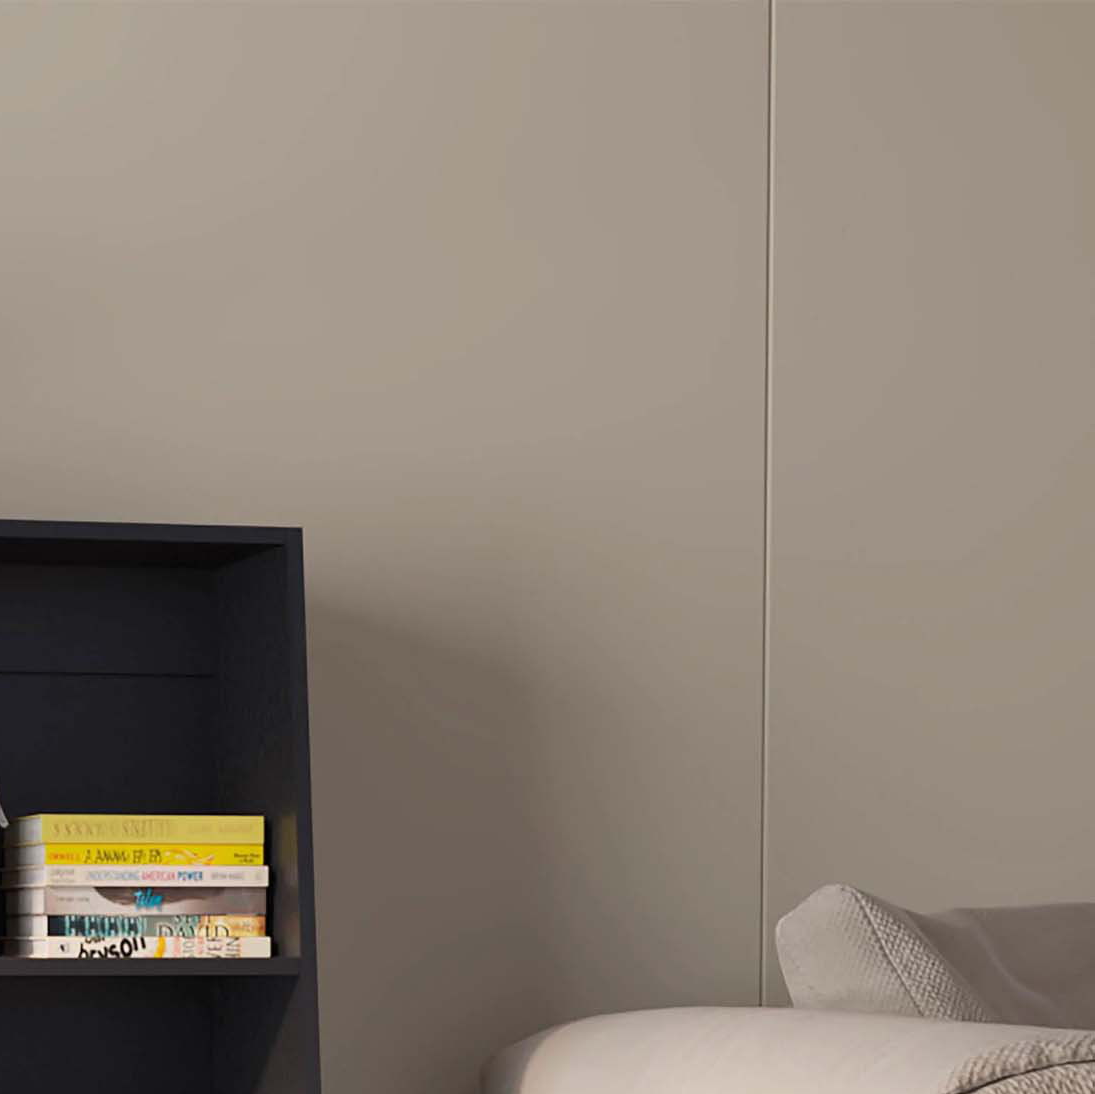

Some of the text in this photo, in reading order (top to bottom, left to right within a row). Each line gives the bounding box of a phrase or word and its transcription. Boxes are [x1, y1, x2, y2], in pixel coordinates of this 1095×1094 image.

[141, 871, 176, 881] AMERICAN
[177, 870, 203, 881] POWER
[156, 923, 230, 937] DAVID
